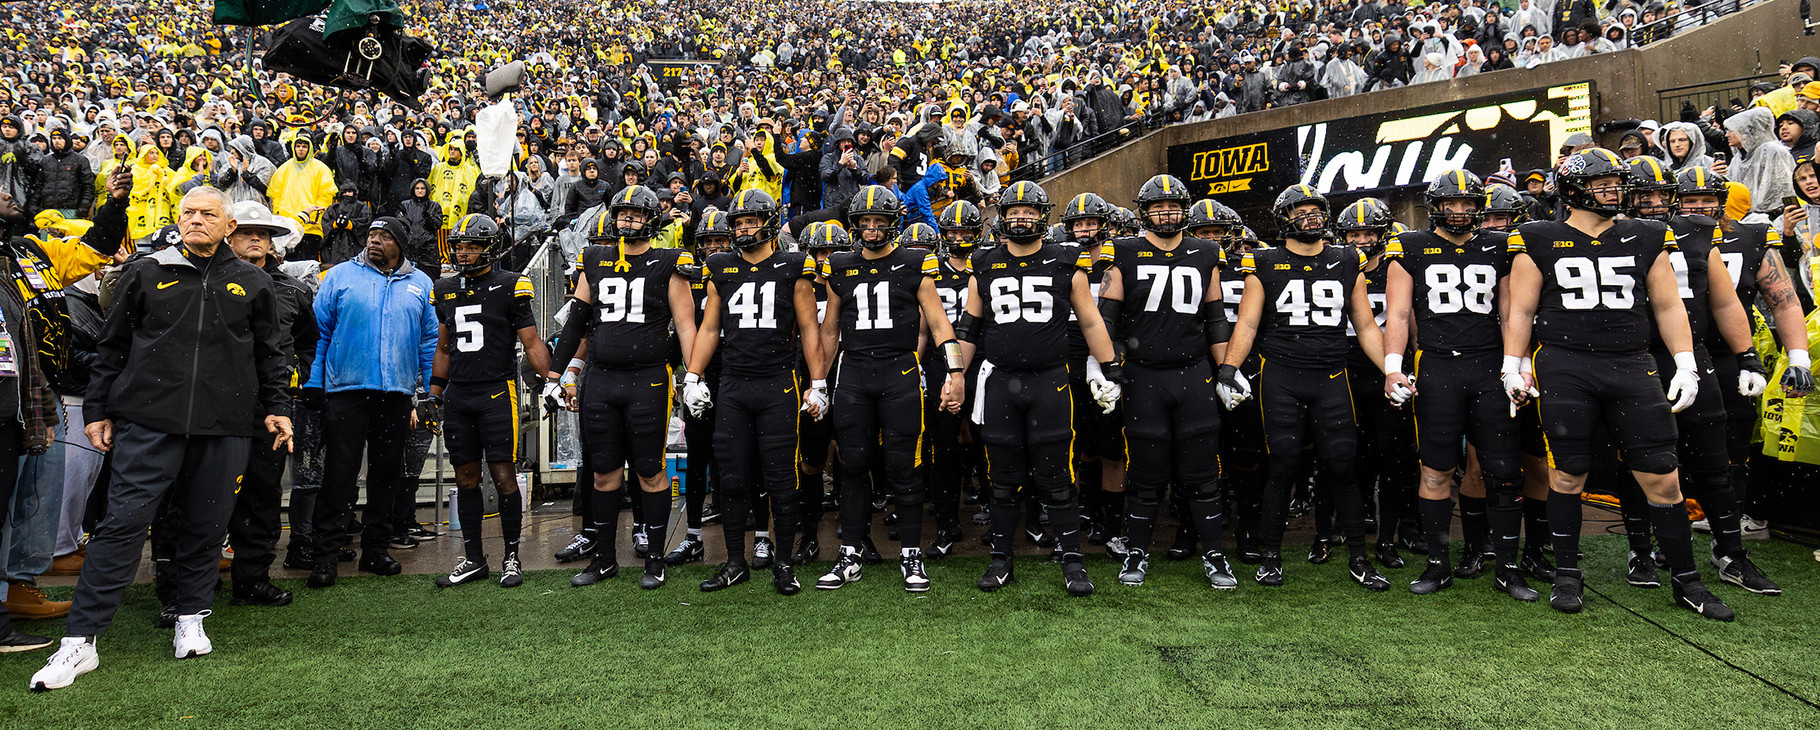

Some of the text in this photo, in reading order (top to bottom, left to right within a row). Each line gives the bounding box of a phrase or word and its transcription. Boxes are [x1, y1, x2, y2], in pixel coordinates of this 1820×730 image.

[1191, 142, 1269, 181] IOWA
[598, 277, 646, 324] 91
[727, 281, 777, 329] 41
[852, 280, 893, 330] 11
[989, 276, 1054, 325] 65
[1136, 265, 1203, 314] 70
[1275, 279, 1345, 327] 49
[1425, 263, 1497, 314] 88
[1554, 256, 1636, 310] 95
[454, 304, 484, 353] 5
